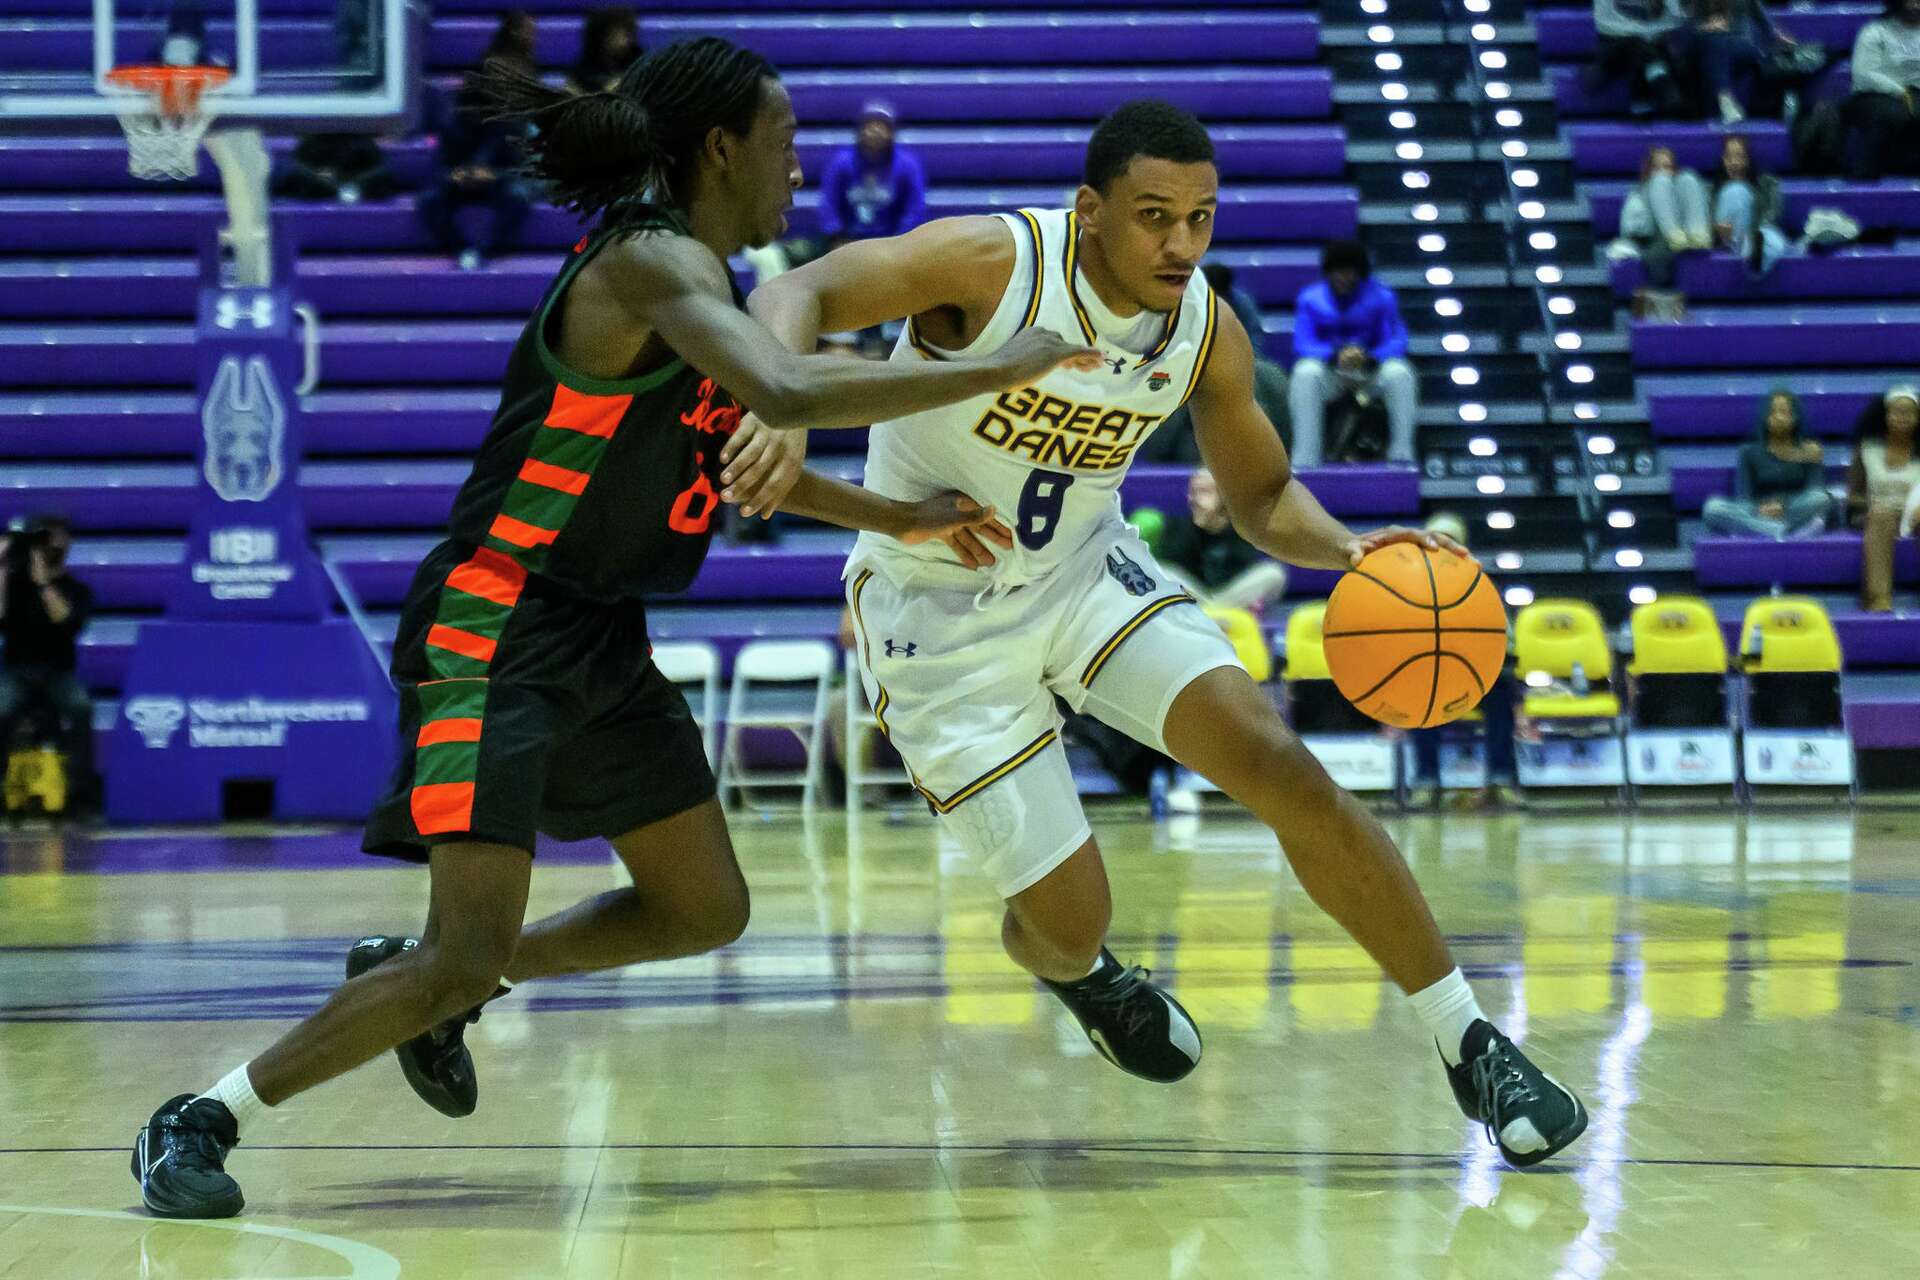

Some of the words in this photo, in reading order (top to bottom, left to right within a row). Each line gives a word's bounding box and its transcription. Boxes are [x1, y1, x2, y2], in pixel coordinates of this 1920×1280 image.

[974, 408, 1137, 471] DANES
[995, 386, 1166, 443] GREAT
[1016, 467, 1075, 551] 8
